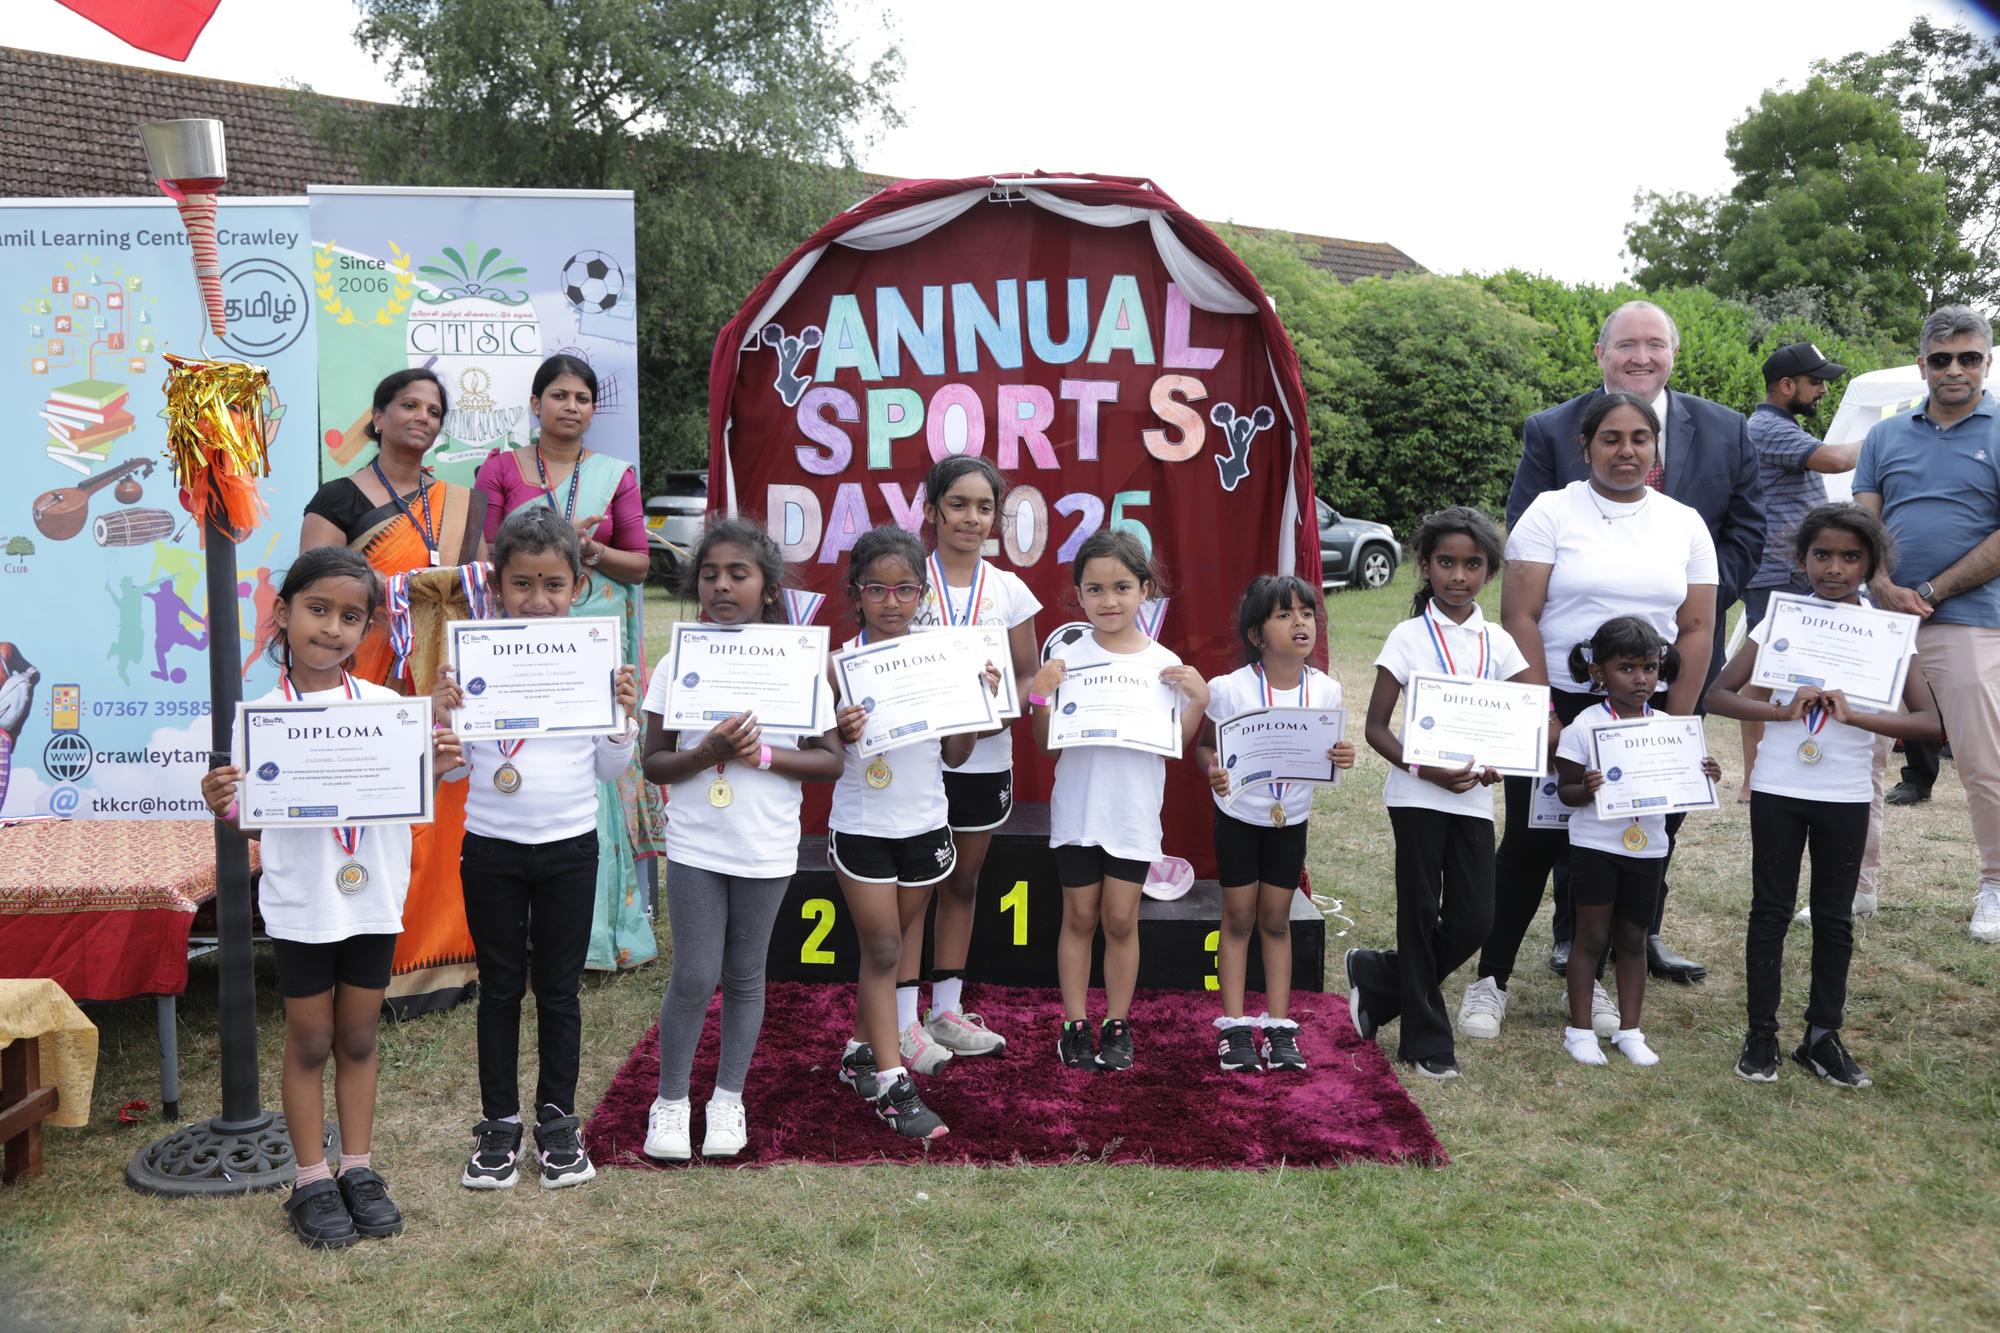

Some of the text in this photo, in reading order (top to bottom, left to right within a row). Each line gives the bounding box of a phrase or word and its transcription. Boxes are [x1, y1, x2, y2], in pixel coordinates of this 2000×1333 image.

[0, 228, 299, 250] mil Learning Cent Crawley
[340, 256, 386, 270] Since
[339, 278, 388, 293] 2006
[224, 290, 296, 324] தமிழ்
[411, 322, 537, 354] CTSC
[815, 274, 1224, 382] ANNUAL
[767, 482, 1153, 568] DAY 025
[1801, 616, 1874, 638] DIPLOMA
[493, 642, 577, 656] DIPLOMA
[710, 644, 786, 657] DIPLOMA
[874, 653, 948, 675] DIPLOMA
[1083, 675, 1149, 688] DIPLOMA
[93, 701, 212, 717] 07367 39585
[1443, 693, 1511, 711] DIPLOMA
[288, 726, 383, 740] DIPLOMA
[1241, 722, 1308, 736] DIPLOMA
[1624, 736, 1683, 749] DIPLOMA
[96, 746, 212, 771] crawleytam
[92, 795, 211, 815] tkkcr@hotm
[1000, 881, 1028, 946] 1
[800, 898, 836, 964] 2
